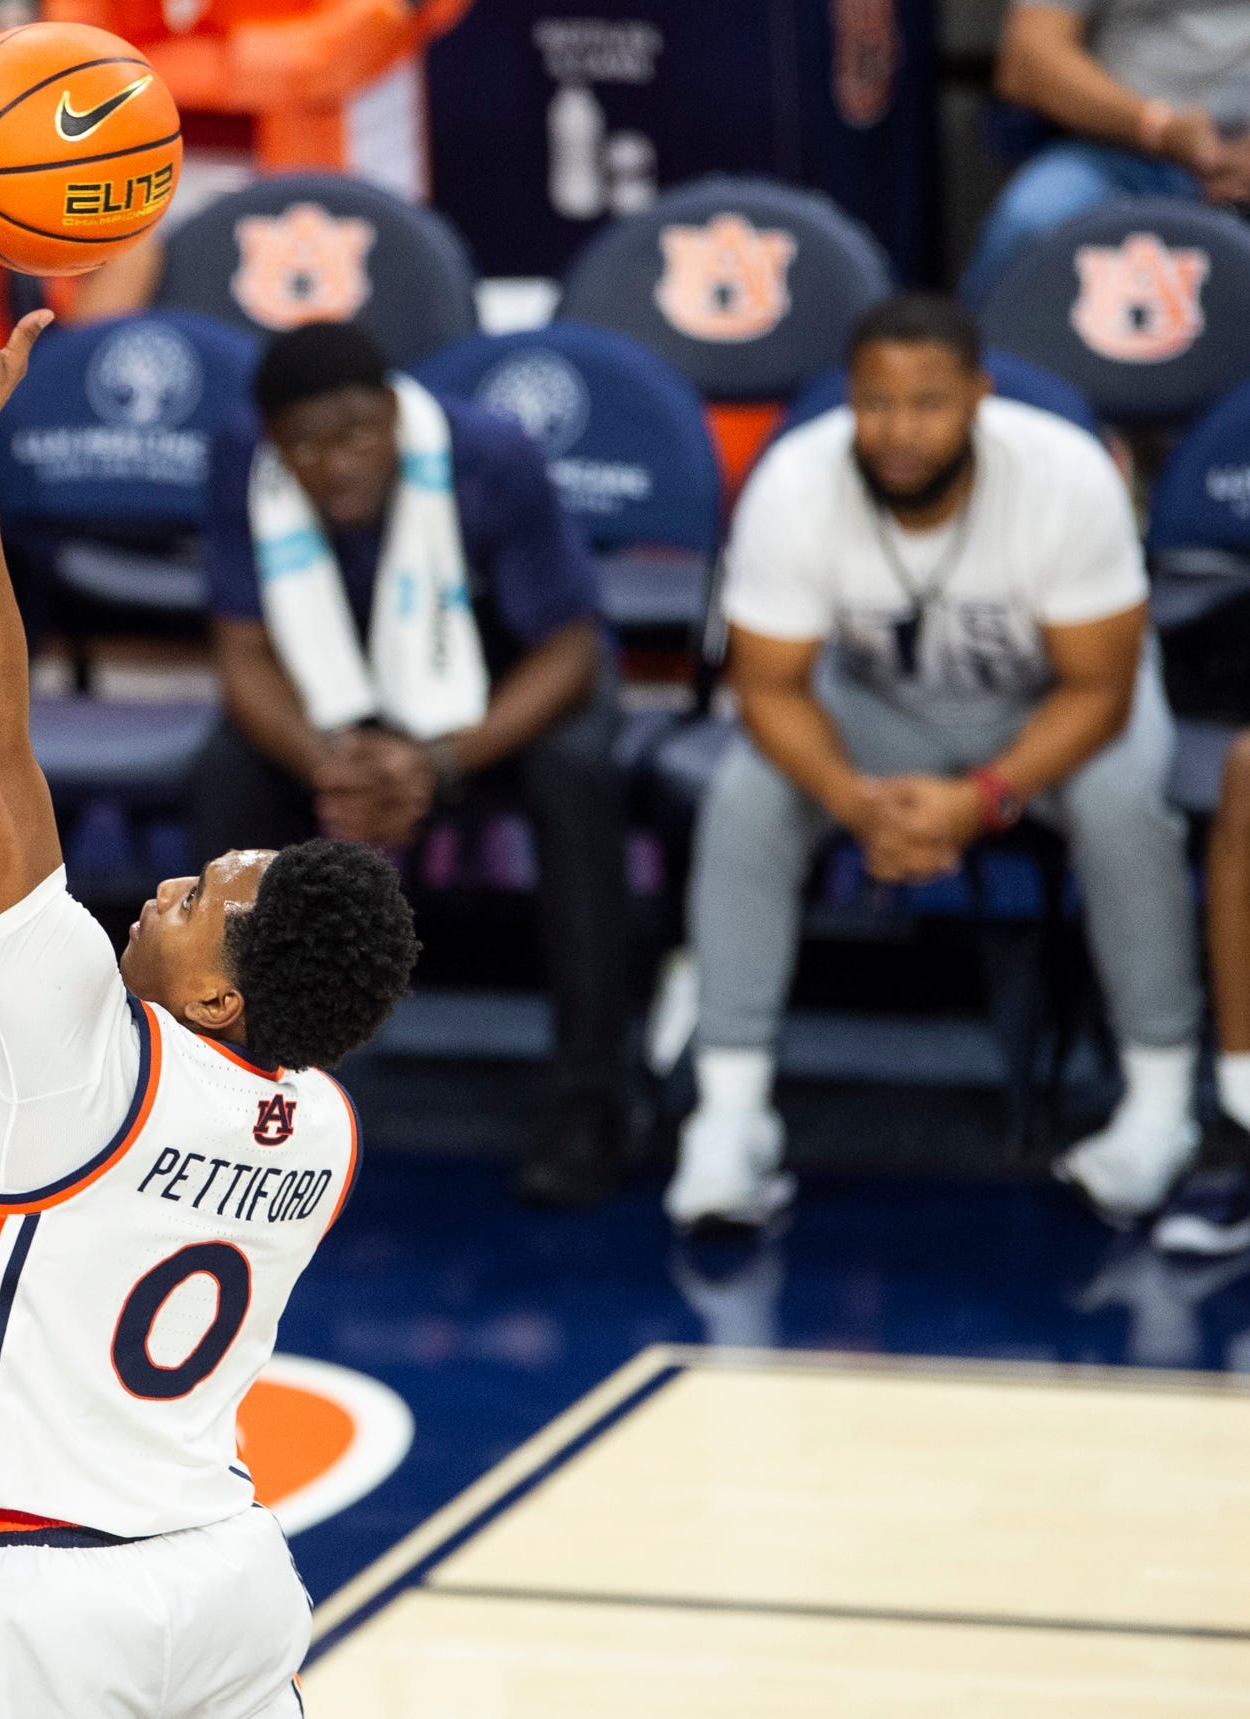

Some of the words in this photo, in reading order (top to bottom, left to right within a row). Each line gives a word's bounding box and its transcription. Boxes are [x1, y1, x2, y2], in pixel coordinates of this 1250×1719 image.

[64, 162, 173, 216] ELITE
[137, 1146, 333, 1223] PETTIFORD
[110, 1239, 252, 1401] 0
